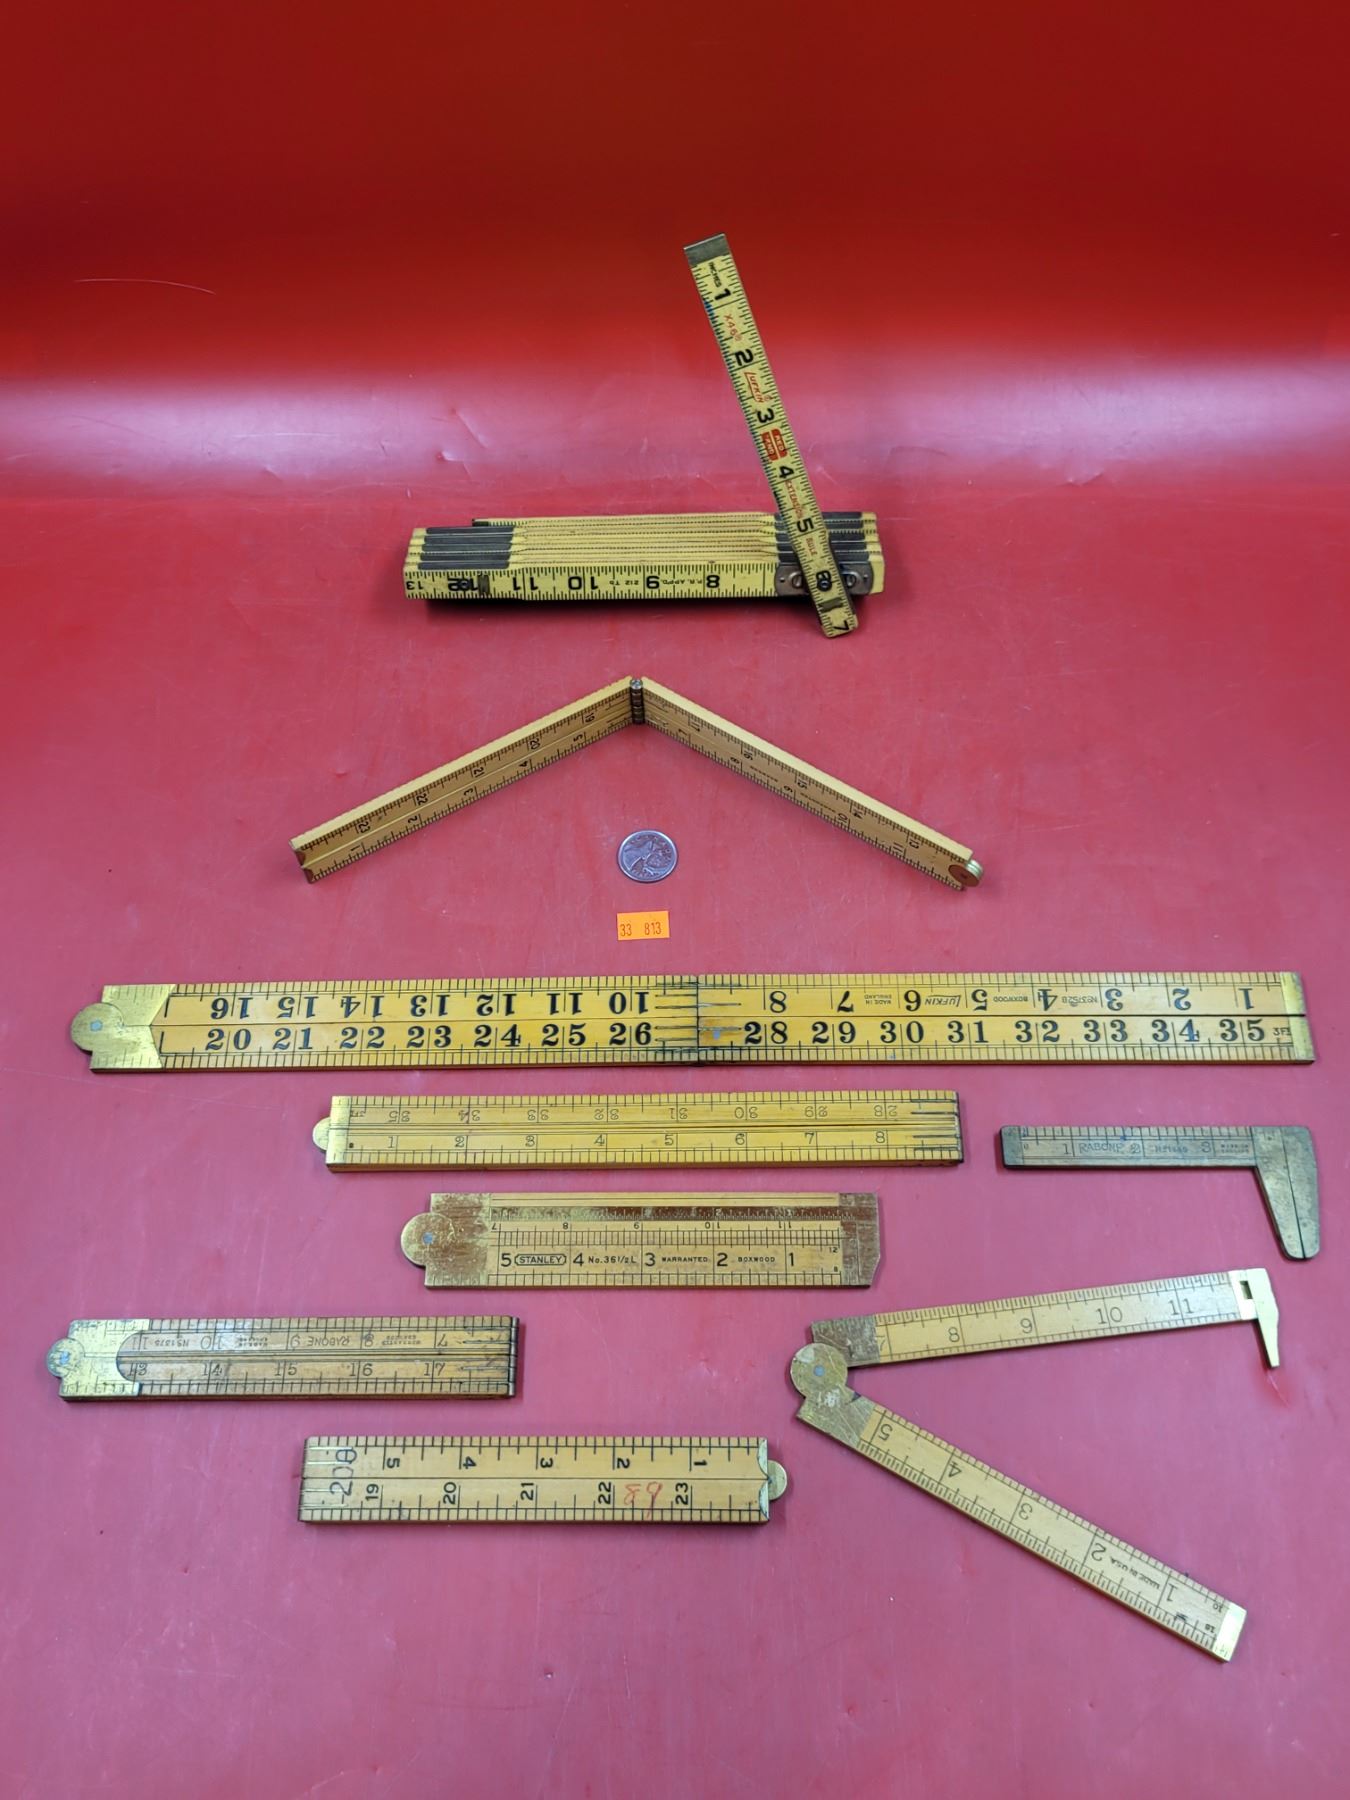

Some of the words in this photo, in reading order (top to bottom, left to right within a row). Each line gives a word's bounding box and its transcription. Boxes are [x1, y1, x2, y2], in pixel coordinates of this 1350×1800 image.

[714, 288, 731, 300] 1
[734, 349, 754, 366] 2
[757, 408, 774, 423] 3
[779, 465, 794, 478] 4
[796, 518, 814, 532] 5
[834, 620, 849, 632] 7
[406, 581, 423, 590] 13
[512, 577, 538, 590] 11
[568, 576, 598, 590] 10
[647, 576, 660, 589] 9
[706, 575, 720, 588] 8
[407, 815, 418, 824] 2
[463, 788, 474, 797] 3
[620, 923, 632, 937] 33
[644, 922, 662, 936] 813
[277, 996, 319, 1019] 15
[340, 996, 385, 1018] 14
[410, 994, 450, 1017] 13
[476, 993, 518, 1016] 12
[547, 992, 583, 1015] 11
[608, 991, 650, 1015] 10
[769, 990, 787, 1013] 8
[837, 990, 854, 1013] 7
[903, 990, 921, 1012] 6
[925, 994, 961, 1008] LUFKIN
[971, 989, 988, 1011] 5
[1037, 988, 1059, 1011] 4
[1104, 988, 1123, 1011] 3
[1172, 988, 1192, 1011] 2
[1238, 988, 1254, 1010] 1
[210, 996, 254, 1020] 16
[205, 1028, 252, 1051] 20
[272, 1028, 313, 1050] 21
[339, 1026, 385, 1049] 22
[407, 1025, 451, 1048] 23
[474, 1024, 521, 1047] 24
[541, 1023, 586, 1047] 25
[609, 1022, 652, 1046] 26
[744, 1021, 788, 1045] 28
[811, 1021, 856, 1044] 29
[880, 1020, 924, 1044] 30
[948, 1020, 989, 1044] 31
[1015, 1020, 1060, 1043] 32
[1083, 1019, 1128, 1042] 33
[1151, 1019, 1200, 1042] 34
[1219, 1019, 1265, 1042] 35
[389, 1110, 411, 1123] 35
[527, 1109, 549, 1121] 33
[669, 1107, 688, 1120] 31
[734, 1106, 759, 1119] 30
[804, 1106, 828, 1118] 29
[874, 1105, 898, 1117] 28
[388, 1136, 394, 1148] 1
[455, 1136, 465, 1148] 2
[525, 1135, 535, 1147] 3
[594, 1134, 605, 1146] 4
[664, 1134, 674, 1146] 5
[735, 1133, 745, 1145] 6
[804, 1132, 815, 1144] 7
[875, 1131, 886, 1144] 8
[1063, 1143, 1071, 1155] 1
[501, 1253, 512, 1267] 5
[519, 1256, 562, 1264] STANLEY
[573, 1252, 584, 1267] 4
[645, 1252, 656, 1267] 3
[716, 1252, 728, 1267] 2
[788, 1252, 795, 1267] 1
[948, 1327, 961, 1343] 8
[1020, 1318, 1033, 1334] 9
[1096, 1306, 1123, 1325] 10
[1169, 1298, 1194, 1316] 11
[289, 1334, 300, 1348] 9
[308, 1336, 350, 1346] RABONE
[437, 1334, 448, 1348] 7
[127, 1362, 148, 1377] 13
[202, 1362, 222, 1377] 14
[275, 1362, 298, 1377] 15
[349, 1362, 373, 1377] 16
[424, 1362, 446, 1377] 17
[878, 1423, 893, 1441] 5
[386, 1457, 400, 1469] 5
[462, 1456, 477, 1470] 4
[540, 1457, 554, 1469] 3
[616, 1457, 631, 1469] 2
[693, 1459, 708, 1467] 1
[948, 1461, 963, 1478] 4
[365, 1483, 380, 1501] 19
[442, 1481, 457, 1505] 20
[520, 1482, 535, 1501] 21
[598, 1481, 612, 1505] 22
[675, 1482, 689, 1505] 23
[1018, 1502, 1033, 1521] 3
[1091, 1542, 1107, 1562] 2
[1166, 1583, 1178, 1602] 1
